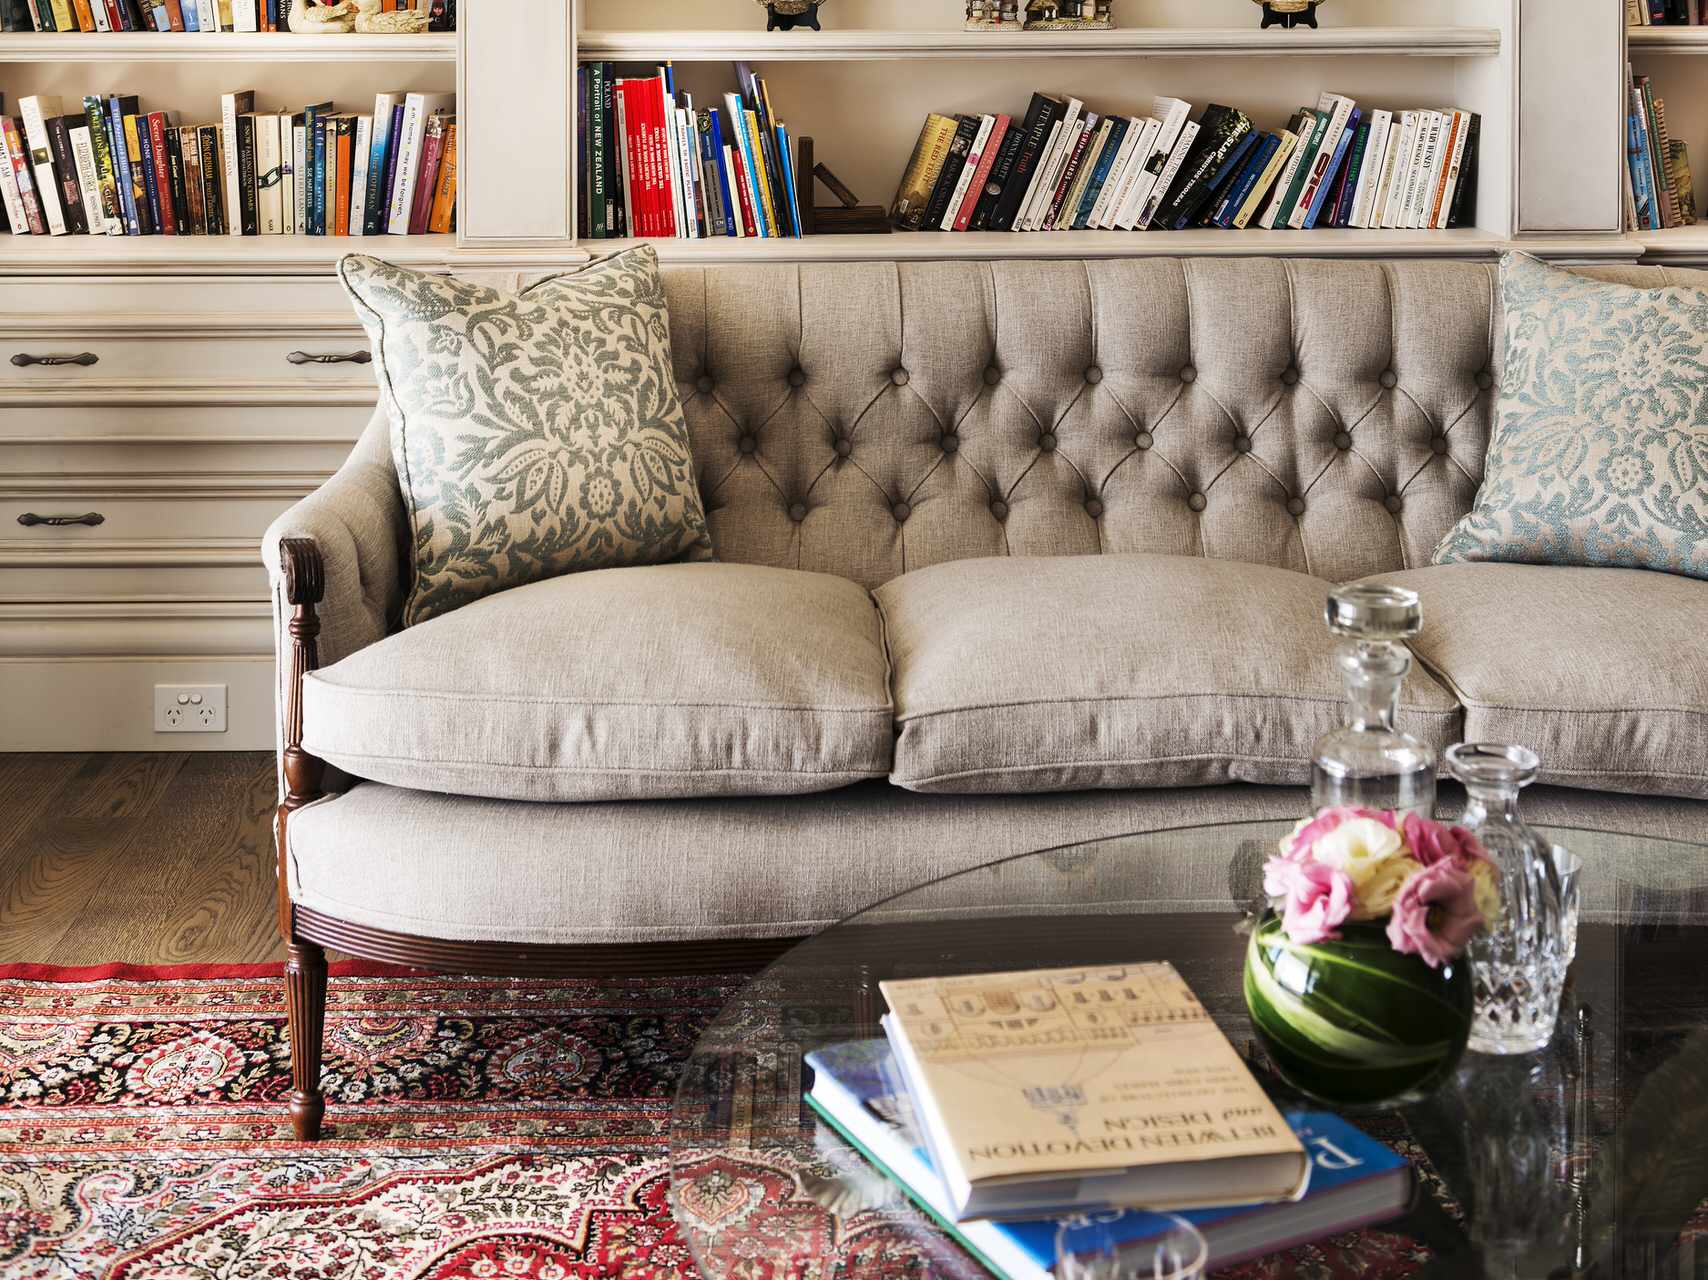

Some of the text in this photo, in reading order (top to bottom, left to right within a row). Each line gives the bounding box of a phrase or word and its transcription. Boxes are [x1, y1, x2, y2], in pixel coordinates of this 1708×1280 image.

[594, 78, 602, 111] Portrait
[594, 113, 600, 122] of
[1028, 107, 1052, 149] TEMPLE
[152, 118, 166, 179] Secret Daughter
[937, 127, 949, 144] THE
[1007, 132, 1021, 156] DONNA
[1216, 122, 1247, 161] THE SLAP
[1413, 127, 1427, 167] MARY WESLEY
[1423, 126, 1439, 168] MARY WESLEY
[90, 104, 113, 216] THREE JUNES JULIA GLASS
[201, 136, 214, 179] JOHN GRISHAM
[930, 144, 942, 161] RED
[247, 173, 253, 184] ON
[401, 179, 407, 187] be
[402, 167, 408, 176] we
[595, 151, 603, 194] ZEALAND
[922, 163, 936, 183] TENT
[1064, 160, 1078, 180] BIRDS
[1173, 151, 1217, 207] CHRISTOS TSIOLKAS
[1284, 154, 1300, 186] AFFLICTION
[369, 172, 379, 210] HOFFMAN
[1102, 1108, 1265, 1132] and DESIGN
[967, 1125, 1278, 1161] BETWEEN DEVOTION
